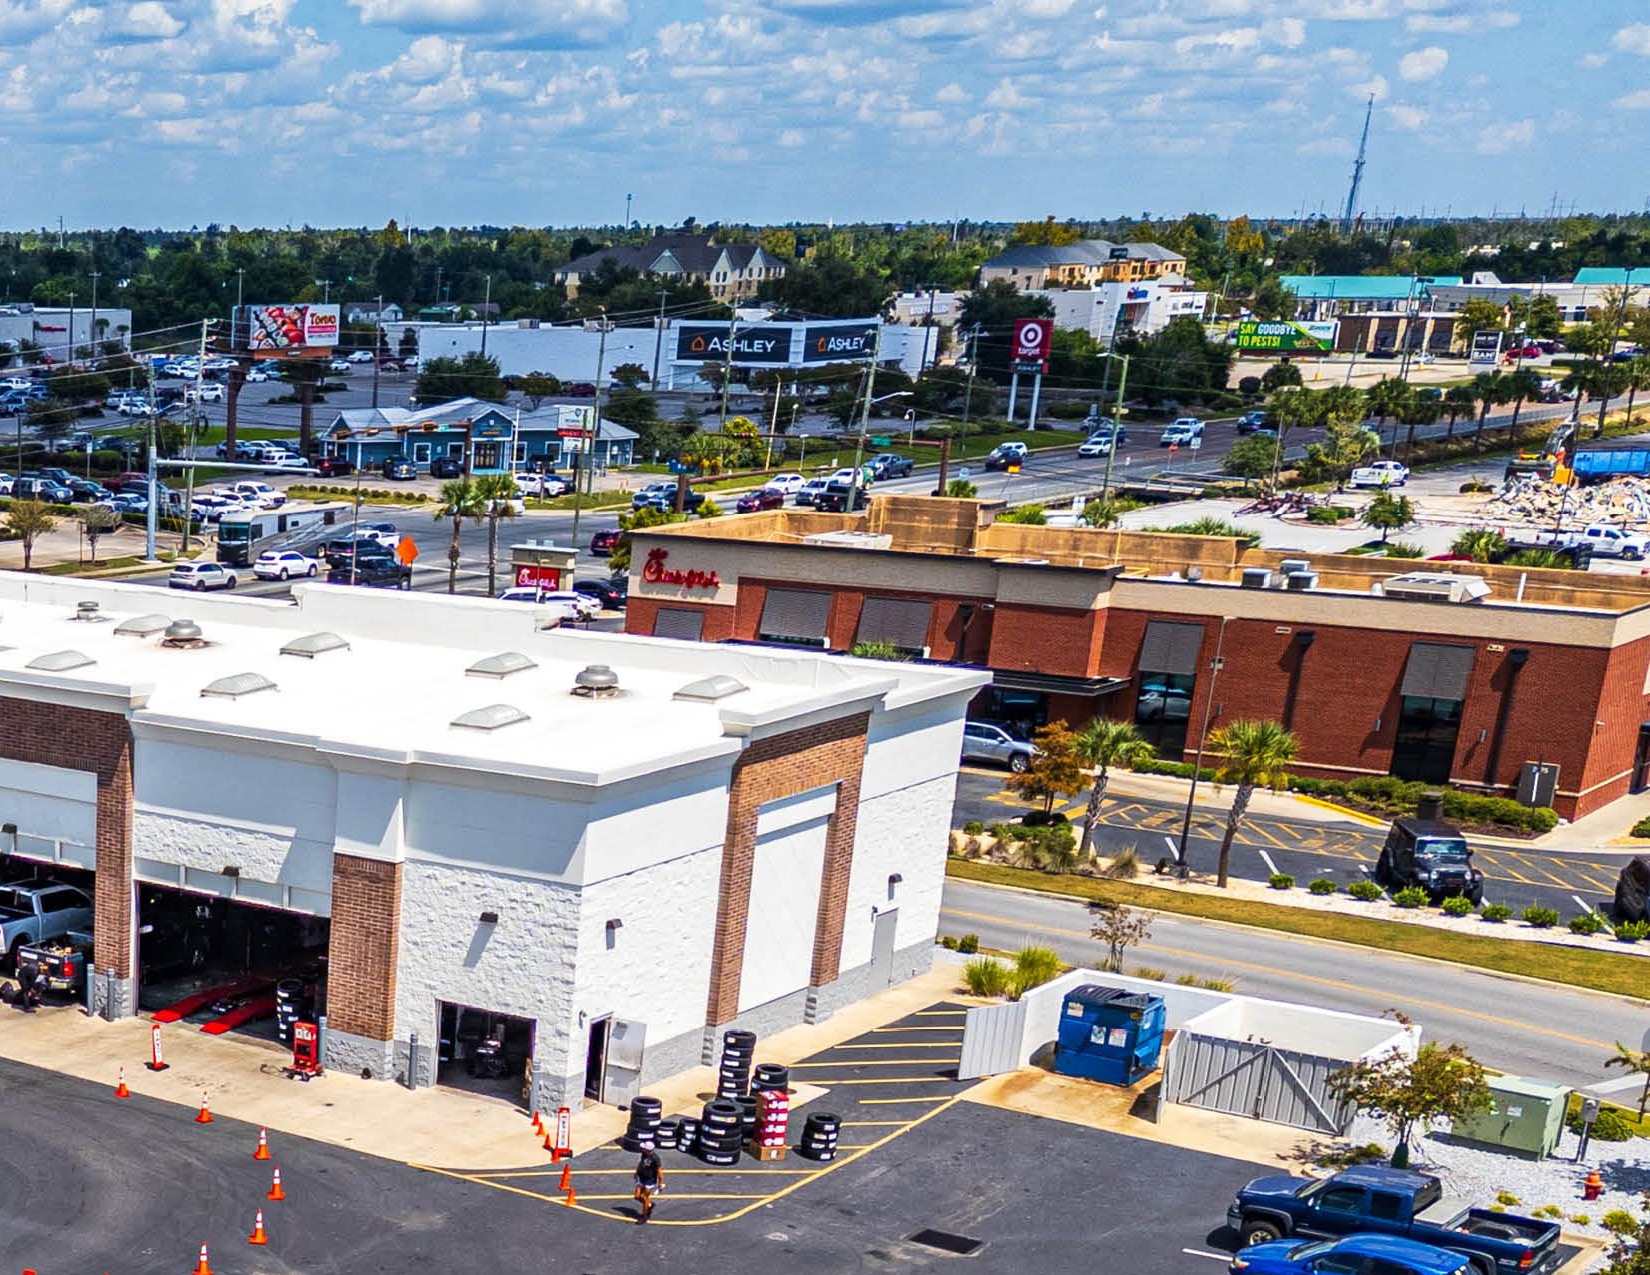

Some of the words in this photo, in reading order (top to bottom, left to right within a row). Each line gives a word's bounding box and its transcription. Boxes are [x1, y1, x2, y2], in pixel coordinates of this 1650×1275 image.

[1240, 324, 1257, 334] SAY
[1258, 324, 1297, 335] GOODBYE
[708, 337, 775, 353] ASHLEY
[827, 337, 865, 351] ASHLEY
[1239, 336, 1249, 346] TO
[1251, 336, 1281, 346] PESTS!
[1018, 347, 1040, 356] target
